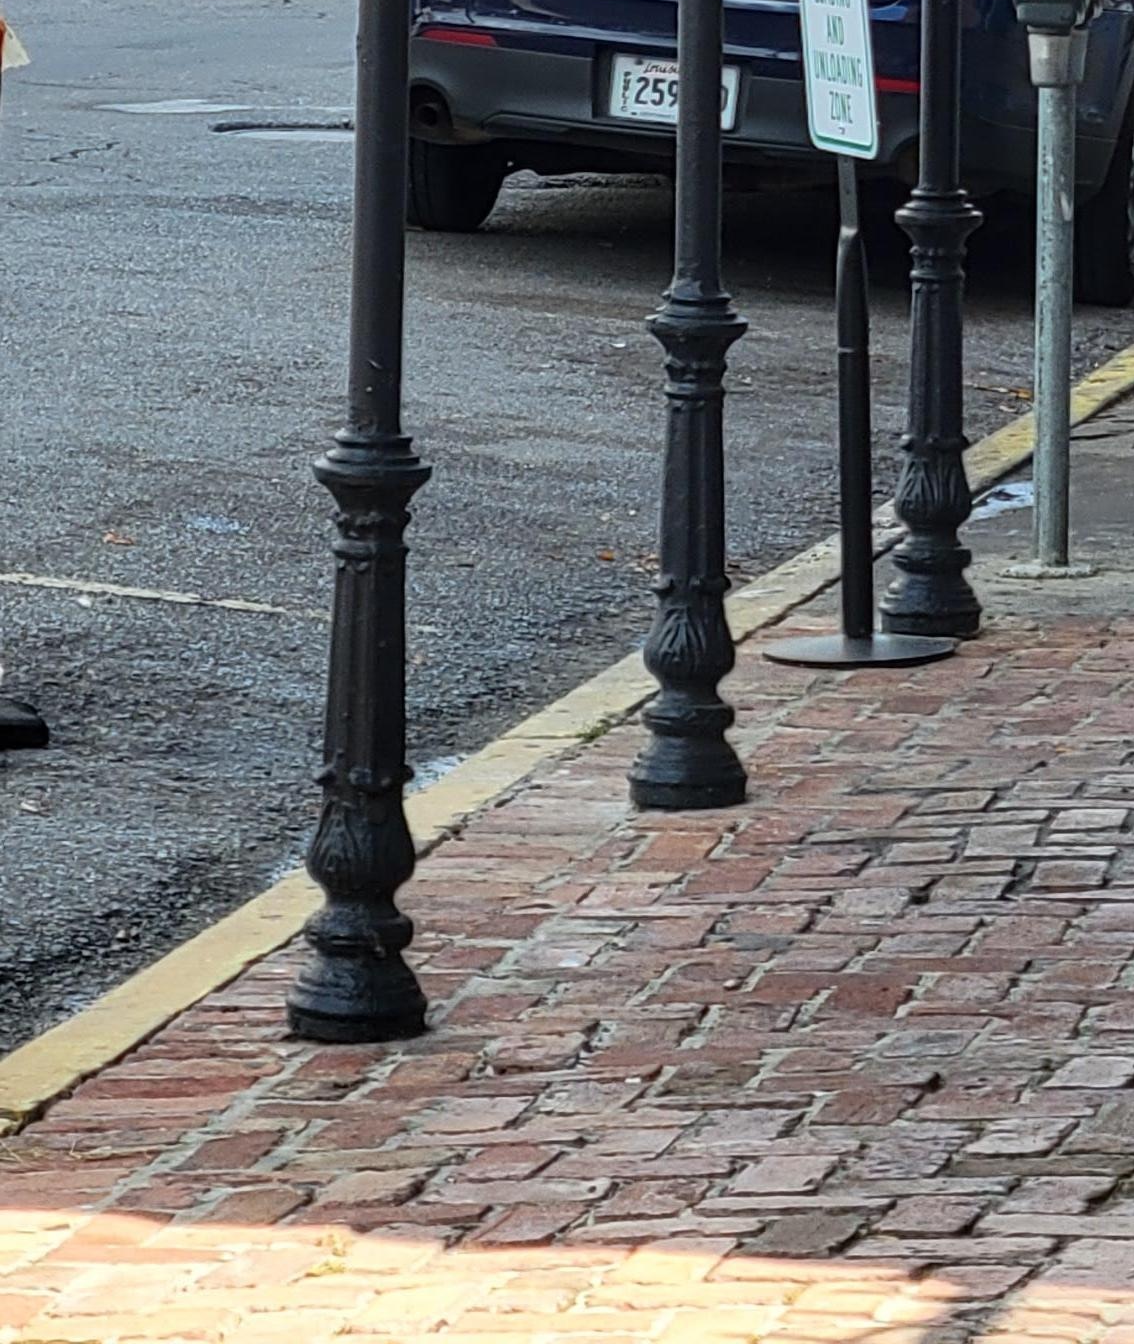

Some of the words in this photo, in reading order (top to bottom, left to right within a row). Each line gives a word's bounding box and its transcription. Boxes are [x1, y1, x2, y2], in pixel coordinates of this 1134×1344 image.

[827, 14, 845, 46] AND
[813, 48, 864, 89] UNLOADING
[829, 90, 854, 124] ZONE
